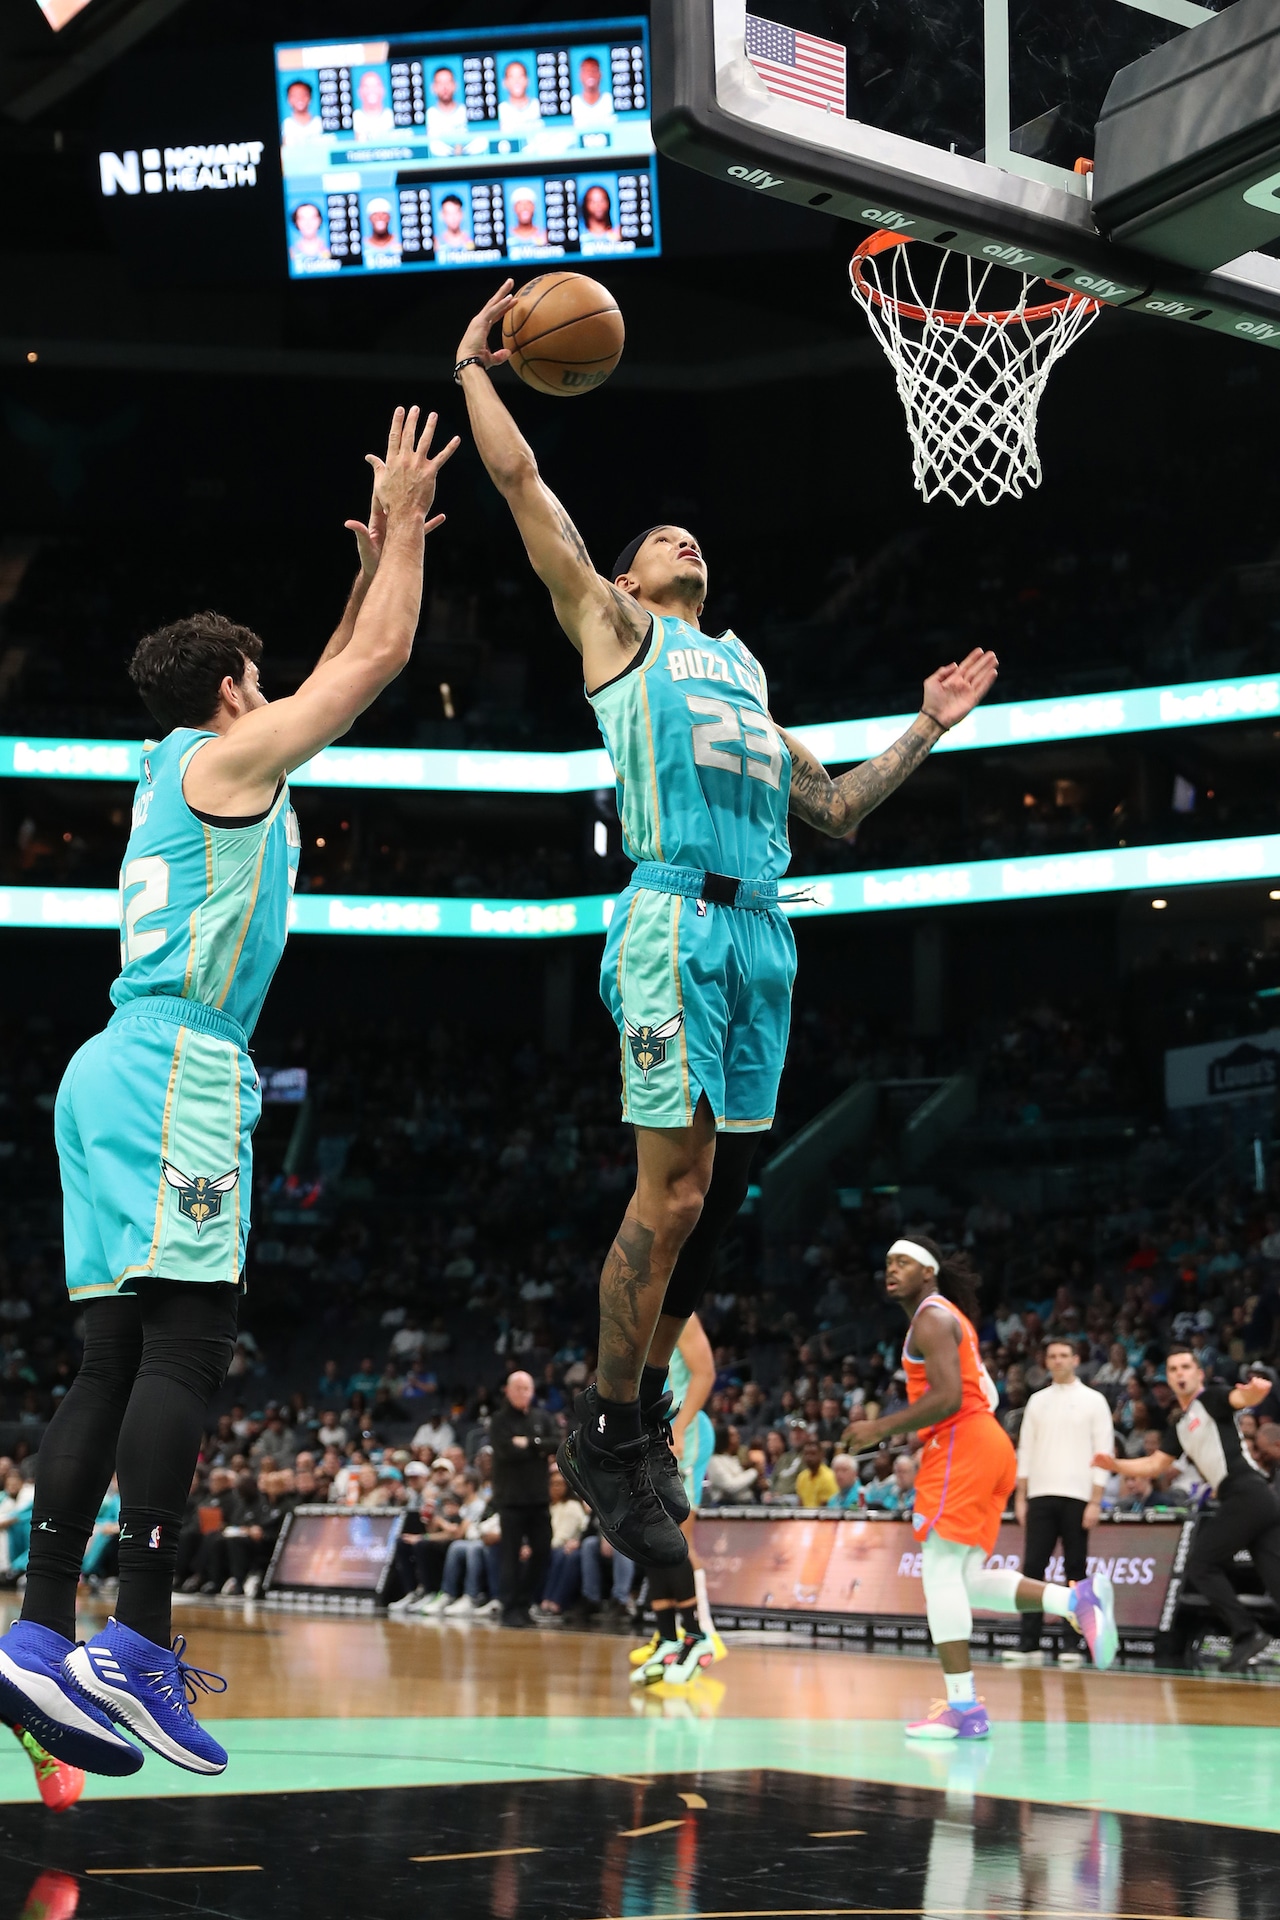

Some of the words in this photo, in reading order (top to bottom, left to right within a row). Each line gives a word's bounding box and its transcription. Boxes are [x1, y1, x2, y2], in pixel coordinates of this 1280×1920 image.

[164, 141, 264, 169] NOVANT
[165, 163, 257, 192] HEALTH
[727, 165, 785, 190] ally
[861, 208, 916, 230] ally
[982, 244, 1034, 265] ally
[1074, 275, 1126, 298] ally
[1145, 299, 1193, 317] ally
[1235, 321, 1280, 340] ally
[664, 648, 736, 686] BUZZ
[1160, 682, 1280, 722] bet365
[686, 694, 783, 792] 23
[13, 742, 130, 774] bet365
[863, 871, 971, 908] bet365
[329, 900, 440, 931] bet365
[471, 903, 577, 933] bet365
